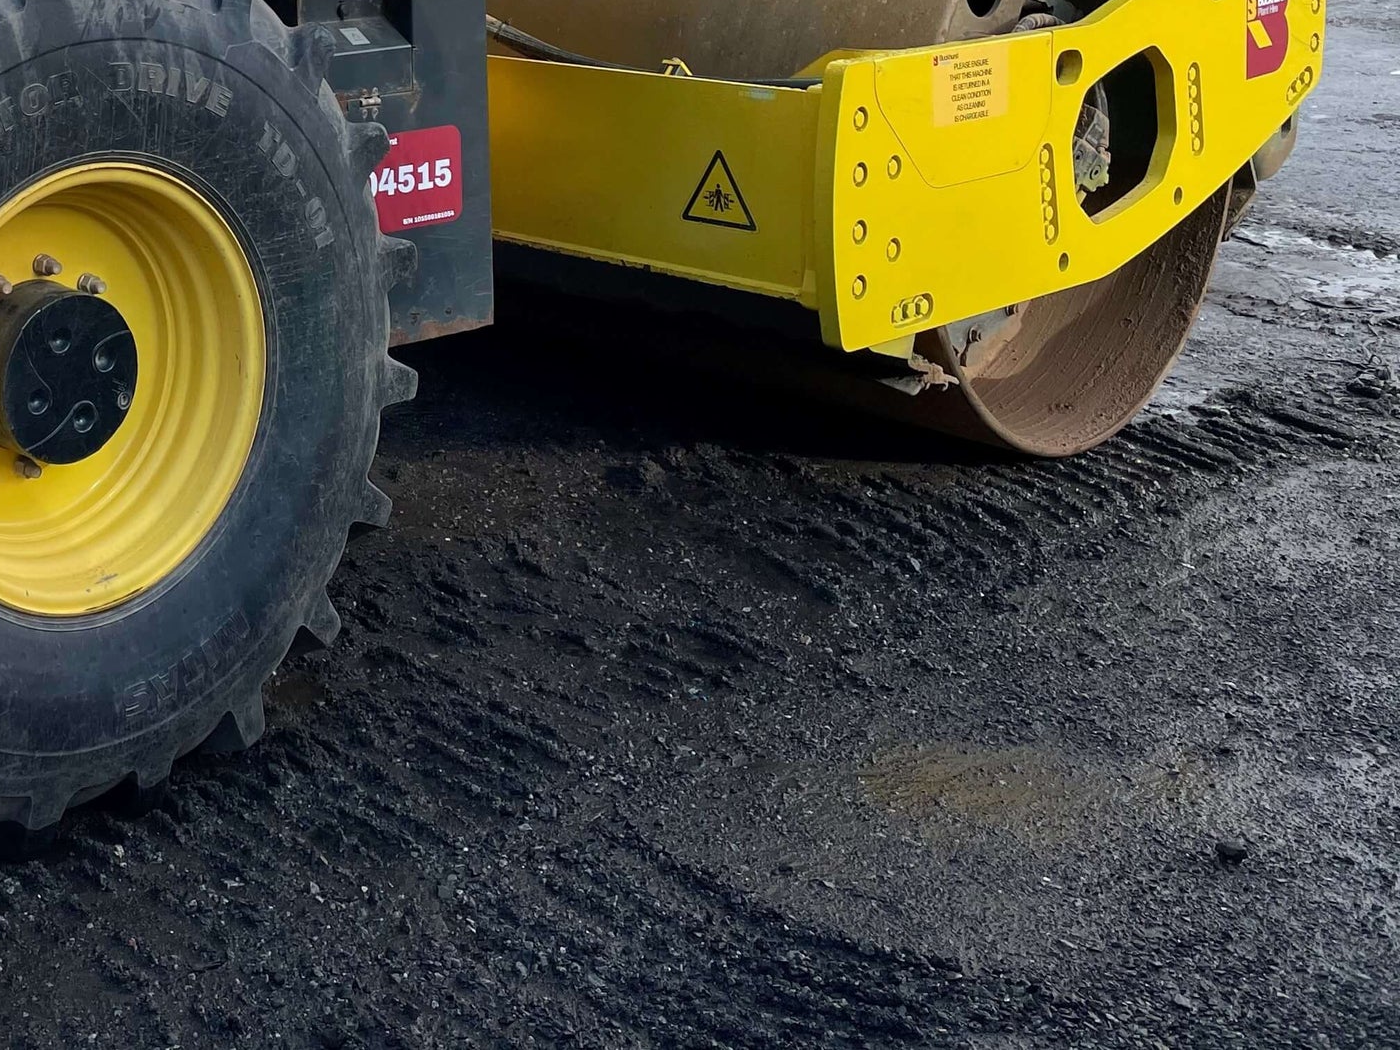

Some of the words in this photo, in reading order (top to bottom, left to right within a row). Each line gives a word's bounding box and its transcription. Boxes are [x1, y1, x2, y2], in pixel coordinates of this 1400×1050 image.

[1258, 7, 1269, 16] Plant
[1269, 5, 1278, 14] Hire
[940, 53, 959, 62] Buckhurst
[954, 61, 970, 70] PLEASE
[972, 58, 989, 67] ENSURE
[950, 72, 961, 81] THAT
[962, 70, 971, 79] THIS
[972, 68, 992, 78] MACHINE
[108, 62, 233, 118] DRIVE
[958, 81, 981, 90] RETURNED
[952, 94, 966, 102] CLEAN
[967, 89, 991, 99] CONDITION
[963, 100, 985, 110] CLEANING
[960, 110, 989, 121] CHARGEABLE
